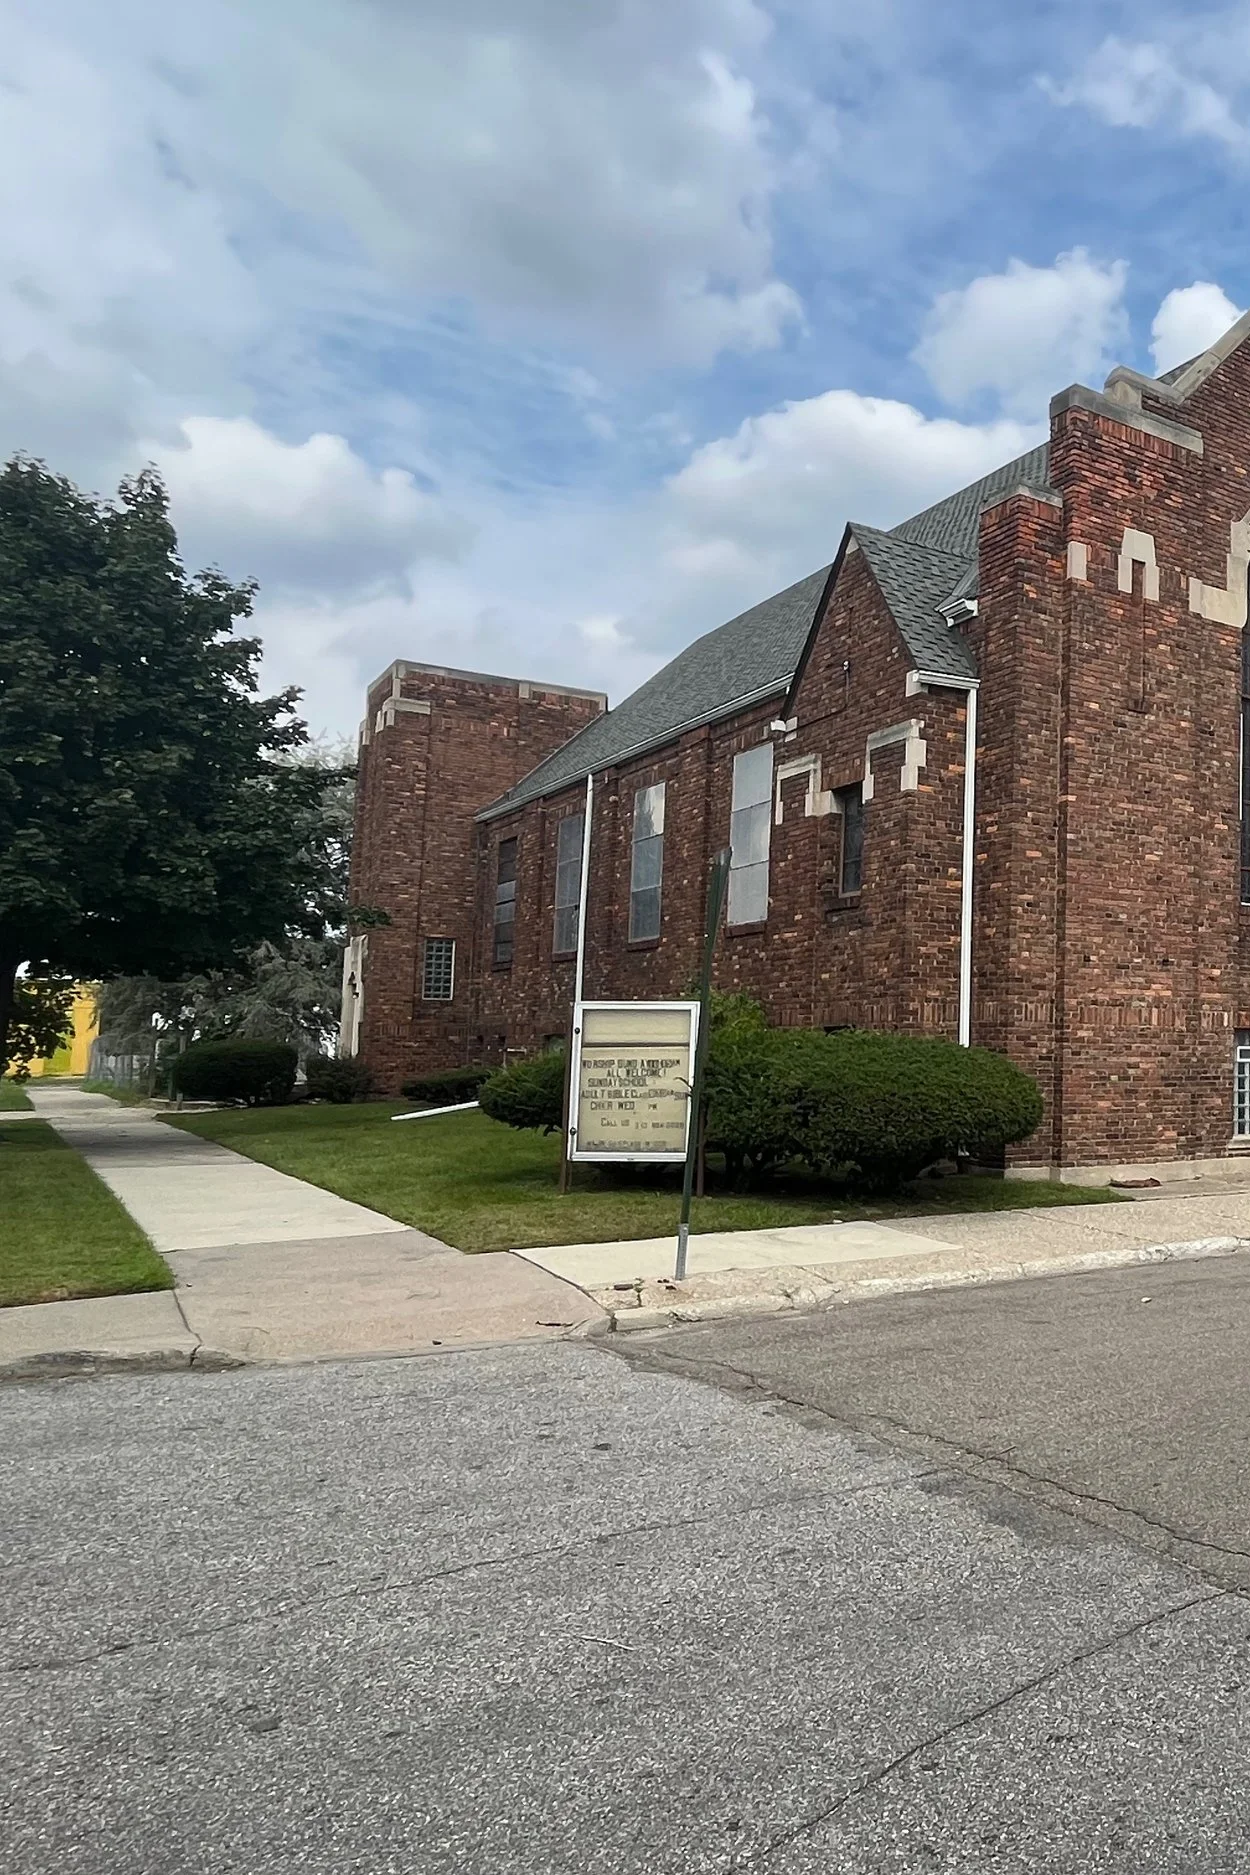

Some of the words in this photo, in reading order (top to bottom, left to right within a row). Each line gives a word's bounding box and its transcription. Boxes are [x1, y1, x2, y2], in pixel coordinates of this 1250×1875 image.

[606, 1069, 621, 1078] ALL
[588, 1078, 617, 1087] SUNDAY
[618, 1078, 649, 1087] SCHOOL
[607, 1089, 630, 1099] BIBLE
